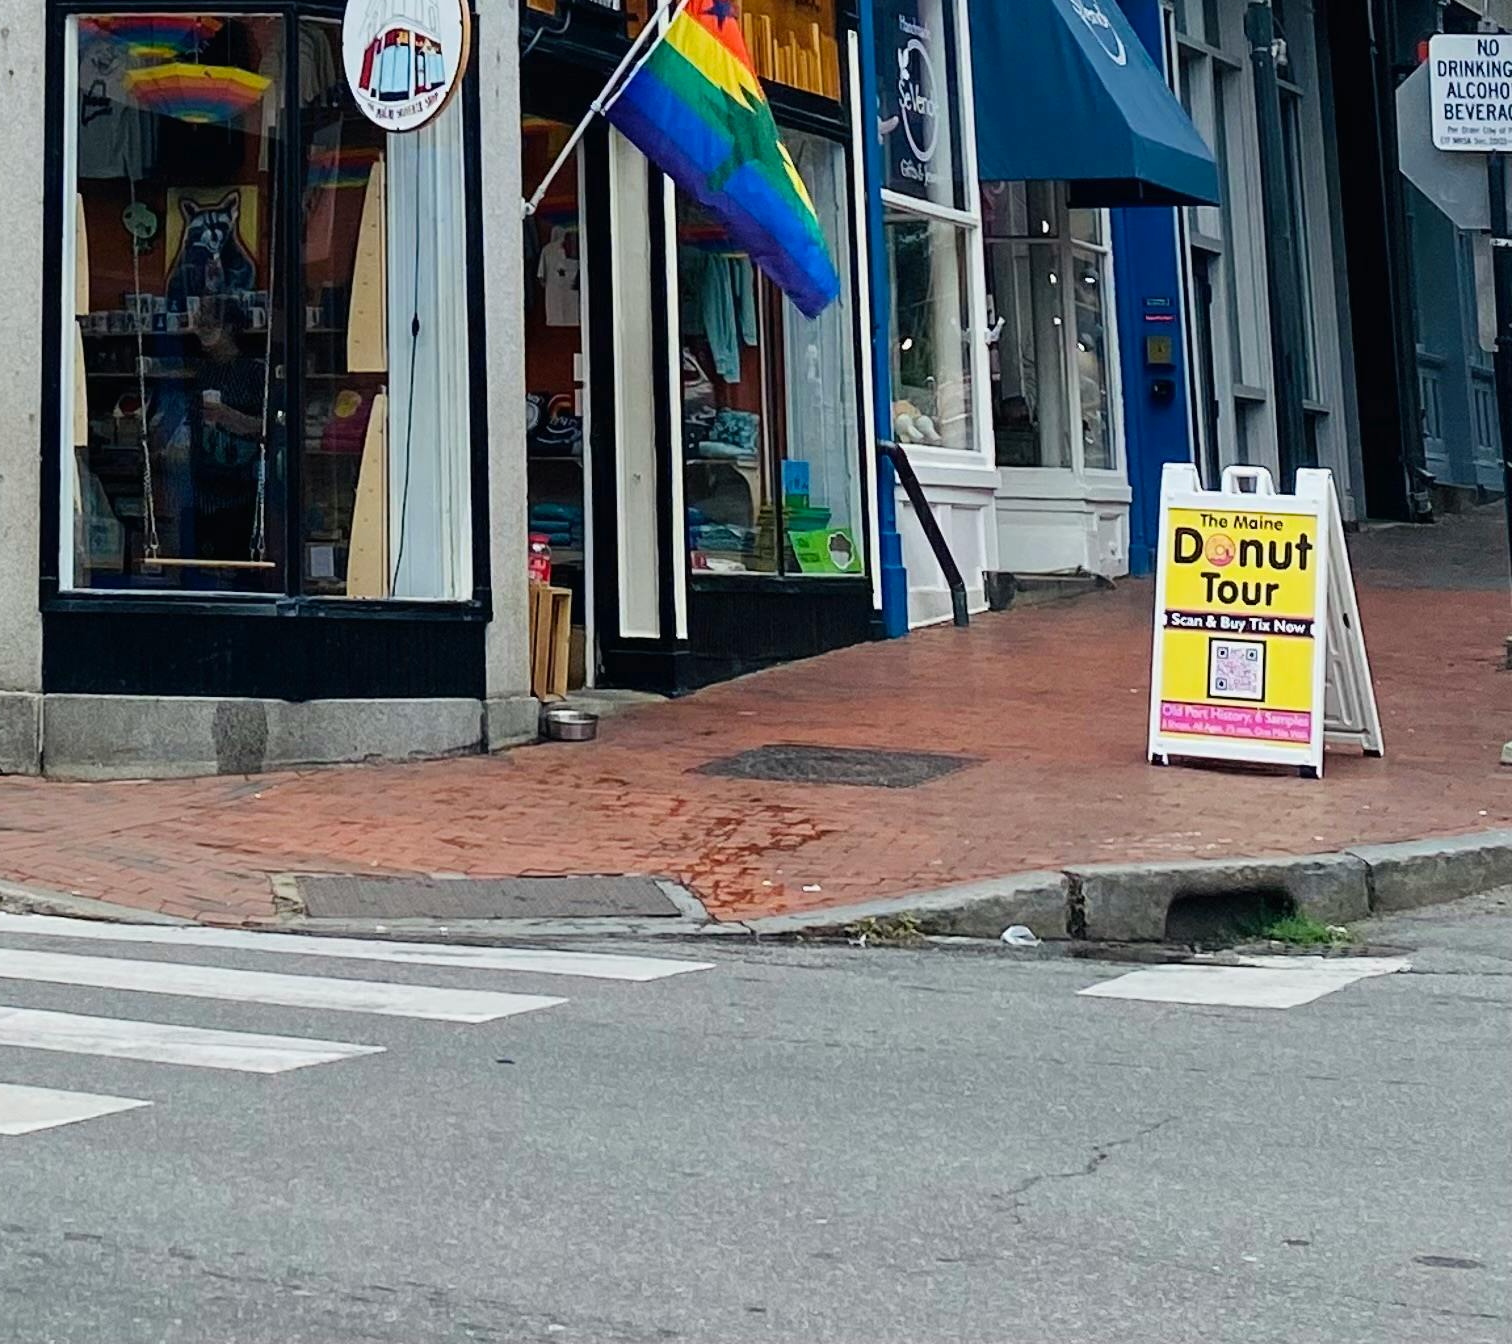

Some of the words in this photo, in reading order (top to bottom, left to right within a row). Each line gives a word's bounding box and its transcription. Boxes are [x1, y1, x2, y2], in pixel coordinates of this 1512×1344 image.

[1477, 39, 1500, 56] NO
[1437, 60, 1512, 78] DRINKING
[1446, 82, 1512, 100] ALCOHO
[1200, 514, 1228, 528] The
[1233, 515, 1284, 531] Maine
[1174, 527, 1313, 570] Donut
[1200, 572, 1280, 606] Tour
[1171, 612, 1203, 628] Scan
[1205, 615, 1218, 628] &
[1220, 616, 1246, 633] Buy
[1249, 618, 1270, 631] Tix
[1273, 621, 1306, 634] Now
[1162, 704, 1182, 717] Old
